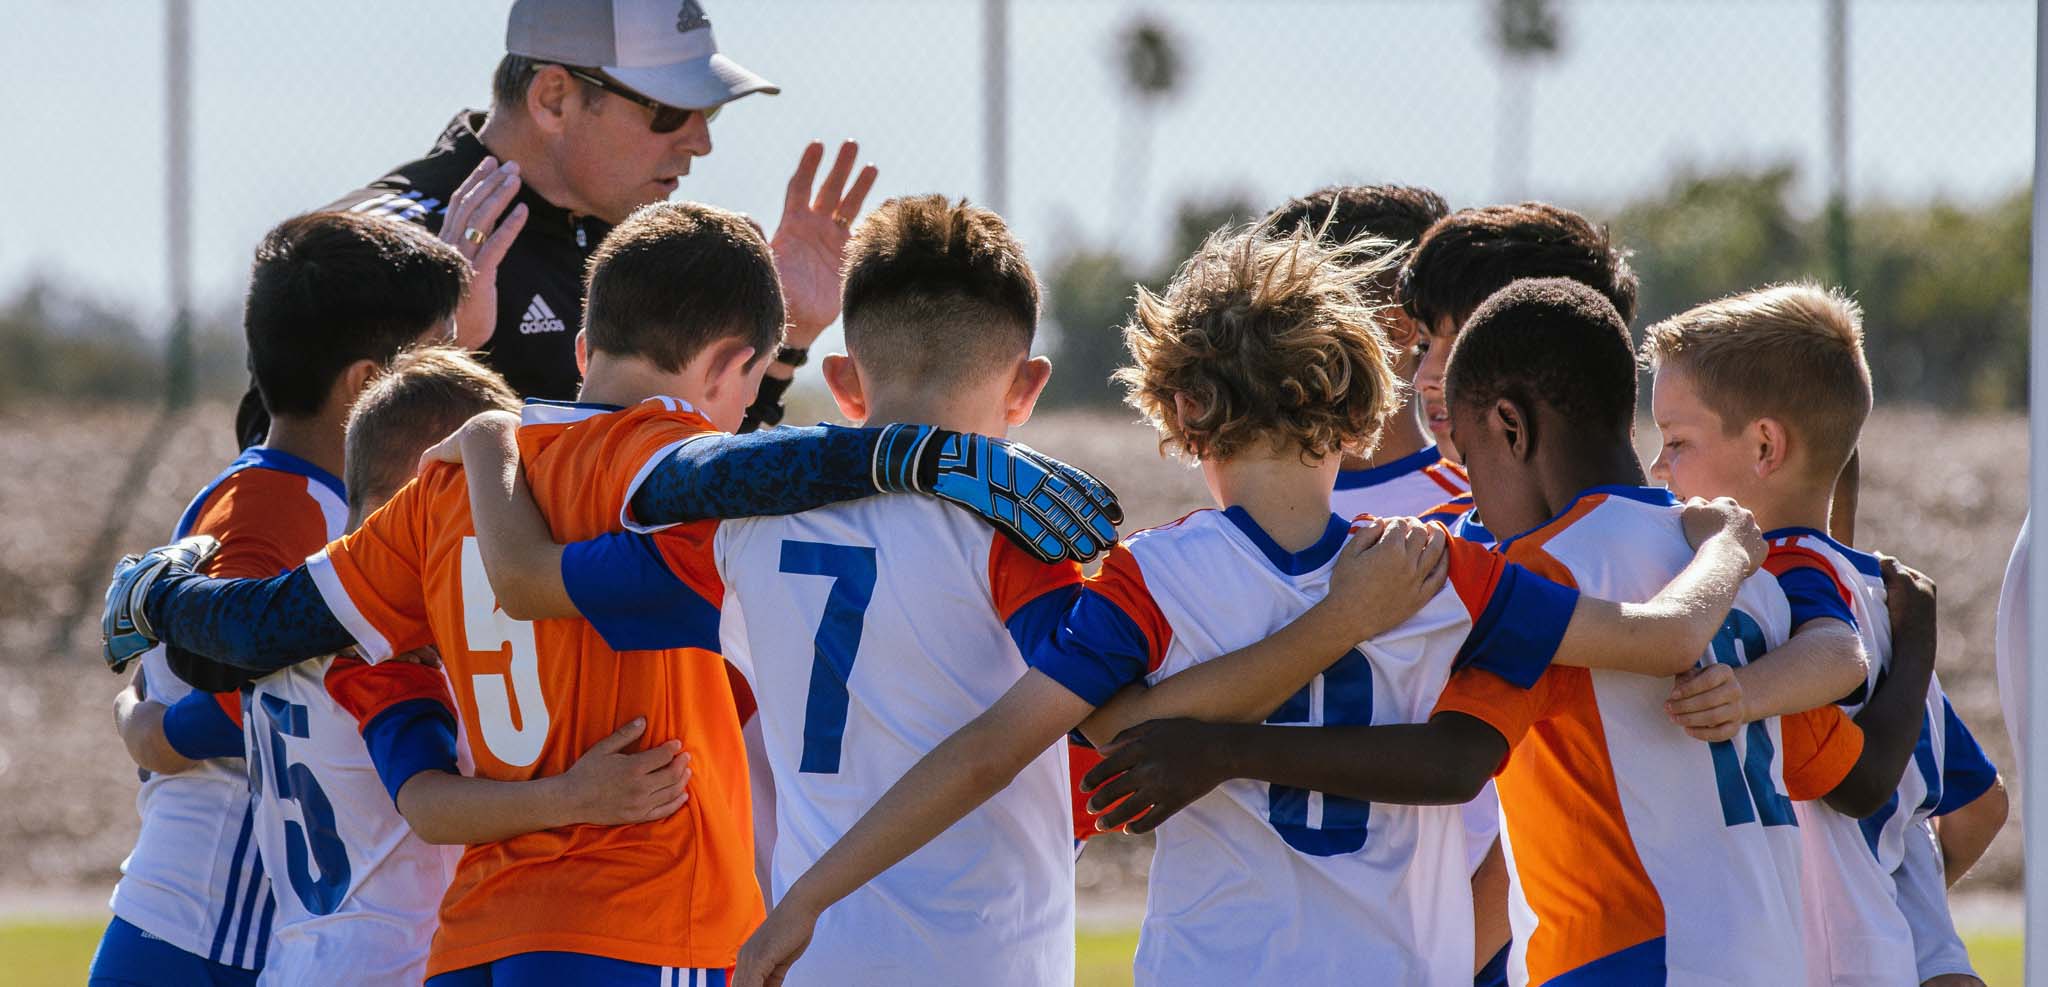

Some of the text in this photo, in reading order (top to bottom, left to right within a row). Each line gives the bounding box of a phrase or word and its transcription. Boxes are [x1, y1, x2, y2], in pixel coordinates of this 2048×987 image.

[461, 536, 550, 767] 5
[778, 539, 877, 774] 7
[260, 691, 352, 916] 5
